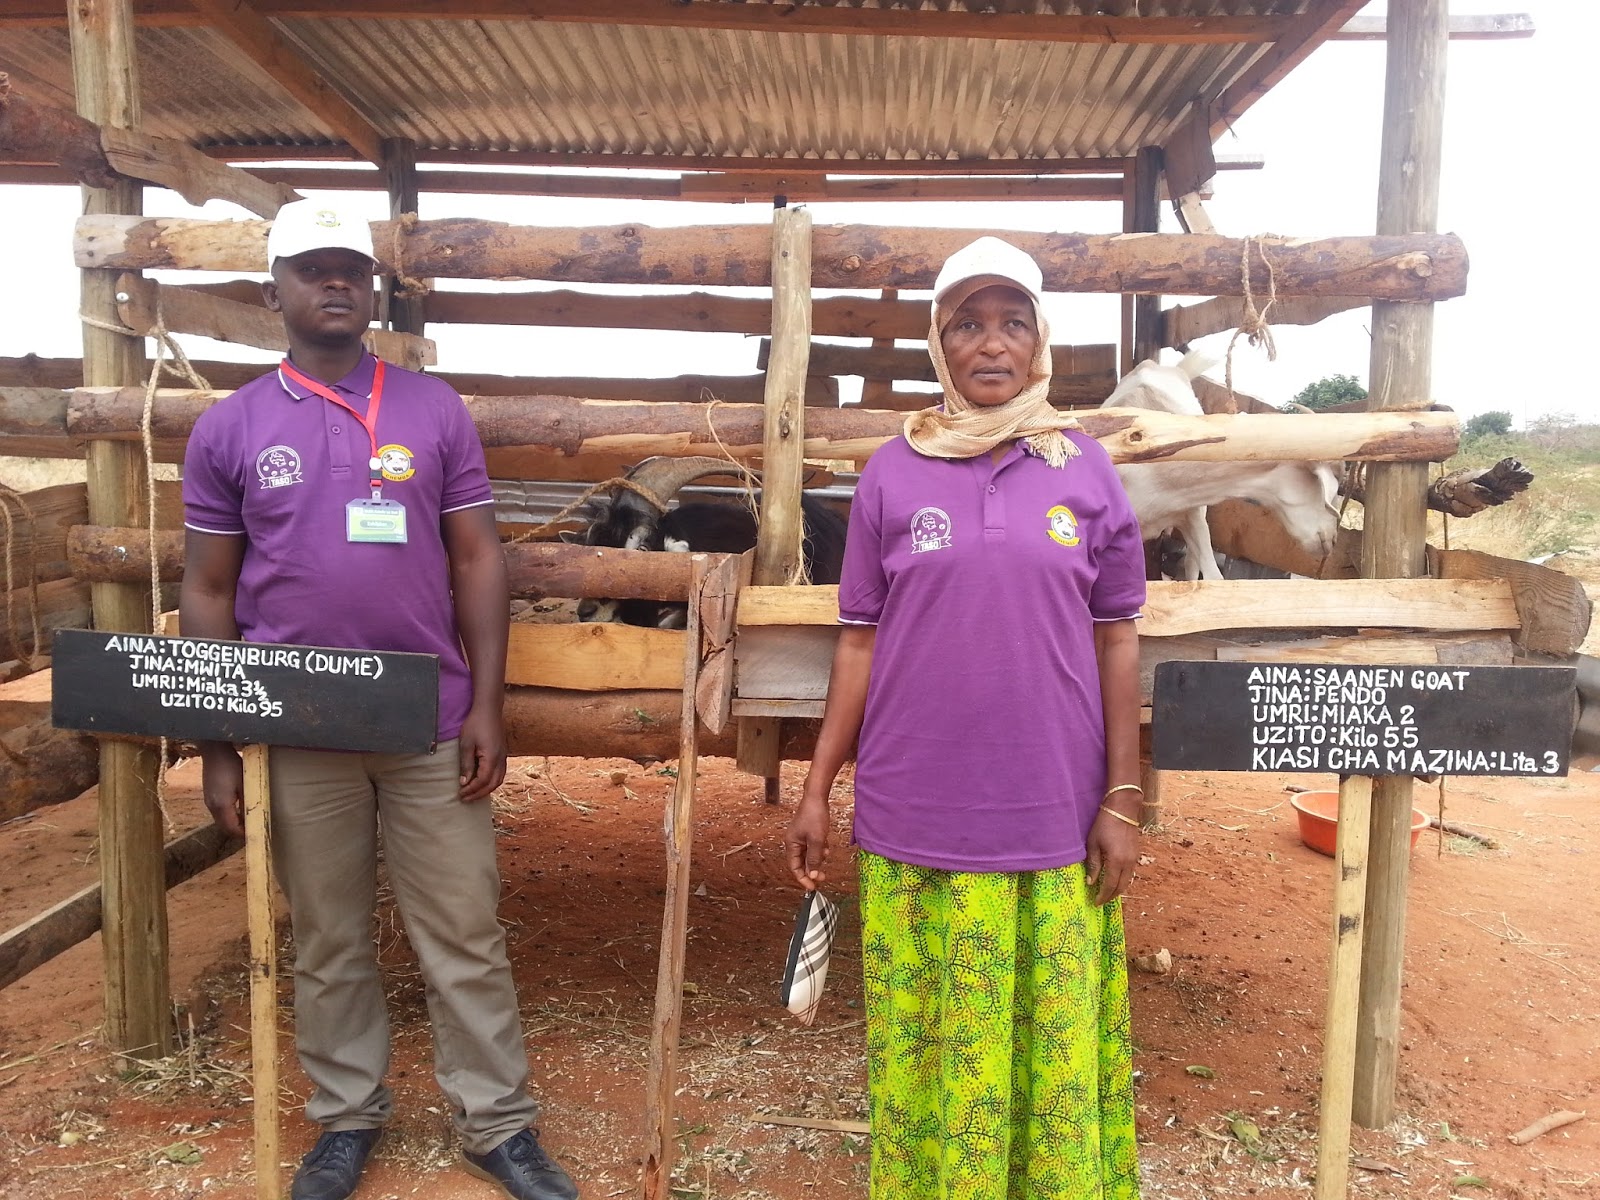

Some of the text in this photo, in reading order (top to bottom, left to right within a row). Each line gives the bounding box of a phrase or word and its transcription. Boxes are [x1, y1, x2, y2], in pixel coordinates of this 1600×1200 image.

[305, 650, 384, 680] (DUME)
[1410, 669, 1471, 691] GOAT
[259, 700, 283, 718] 95
[1399, 704, 1415, 725] 2
[1383, 726, 1419, 749] 55
[1252, 745, 1320, 771] KIASI
[1328, 747, 1381, 770] CHA
